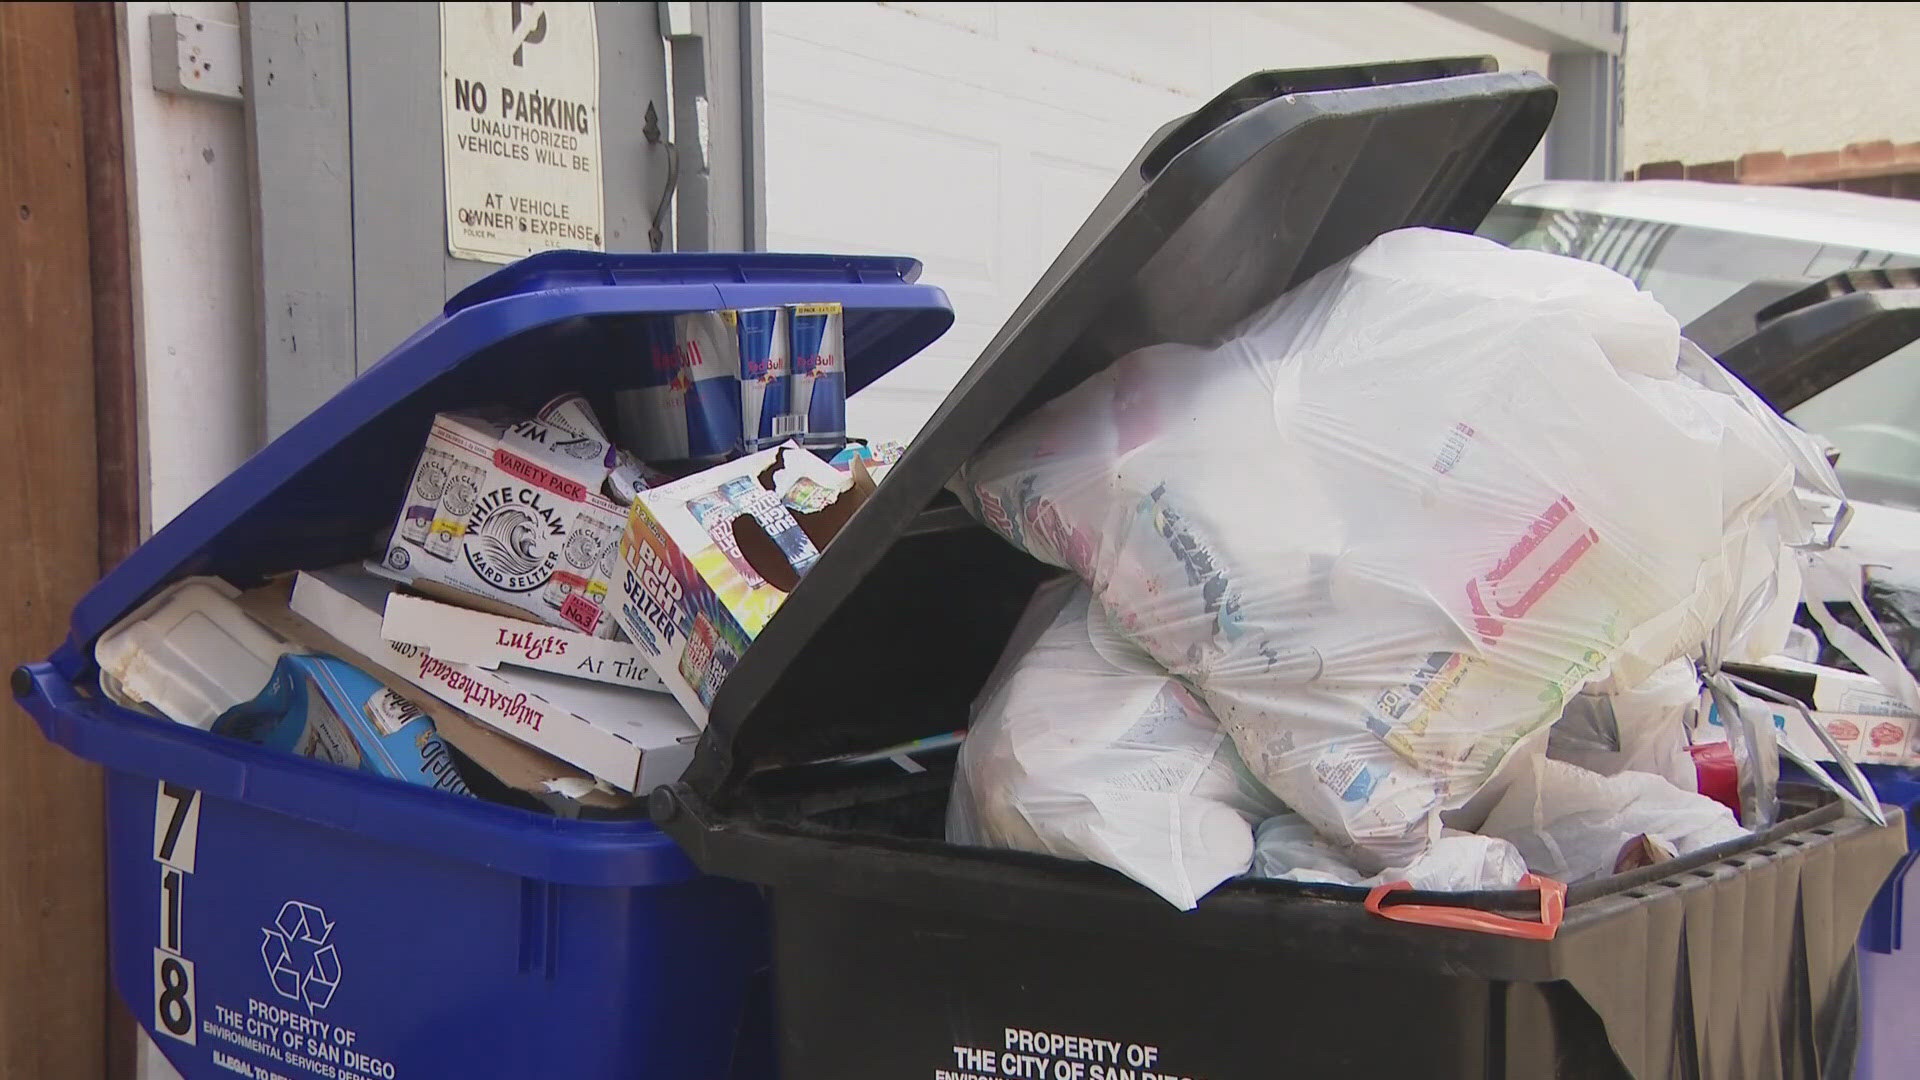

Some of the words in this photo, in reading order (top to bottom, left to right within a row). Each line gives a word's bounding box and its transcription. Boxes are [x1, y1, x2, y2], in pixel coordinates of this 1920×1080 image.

[455, 78, 487, 114] NO
[502, 88, 588, 135] PARKING
[458, 134, 529, 161] VEHICLES
[535, 148, 567, 168] WILL
[573, 155, 590, 172] BE
[471, 117, 577, 151] UNAUTHORIZED
[458, 208, 527, 232] OWNER'S
[531, 219, 593, 241] EXPENSE
[485, 193, 503, 210] AT
[510, 196, 569, 220] VEHICLE
[815, 354, 834, 367] Bull
[500, 453, 548, 483] VARIETY
[550, 479, 582, 499] PACK
[465, 487, 513, 536] WHITE
[519, 489, 566, 535] CLAW
[472, 552, 503, 583] HARD
[509, 551, 558, 588] SELTZER
[626, 545, 687, 627] LIGHT
[639, 539, 684, 602] BUD
[565, 605, 593, 628] No.3
[624, 569, 675, 646] SELTZER
[496, 628, 568, 660] Luigi's
[613, 657, 648, 681] The
[215, 1005, 244, 1031] THE
[247, 1018, 279, 1043] CITY
[282, 1031, 304, 1050] OF
[307, 1038, 340, 1064] SAN
[344, 1049, 395, 1080] DIEGO
[249, 998, 330, 1040] PROPERTY
[334, 1028, 356, 1047] OF
[203, 1021, 283, 1061] ENVIRONMENTAL
[285, 1051, 336, 1079] SERVICES
[213, 1050, 254, 1078] ILLEGAL
[953, 1046, 996, 1073] THE
[1001, 1053, 1050, 1080] CITY
[1054, 1060, 1084, 1080] OF
[1004, 1027, 1122, 1064] PROPERTY
[1126, 1044, 1158, 1069] OF
